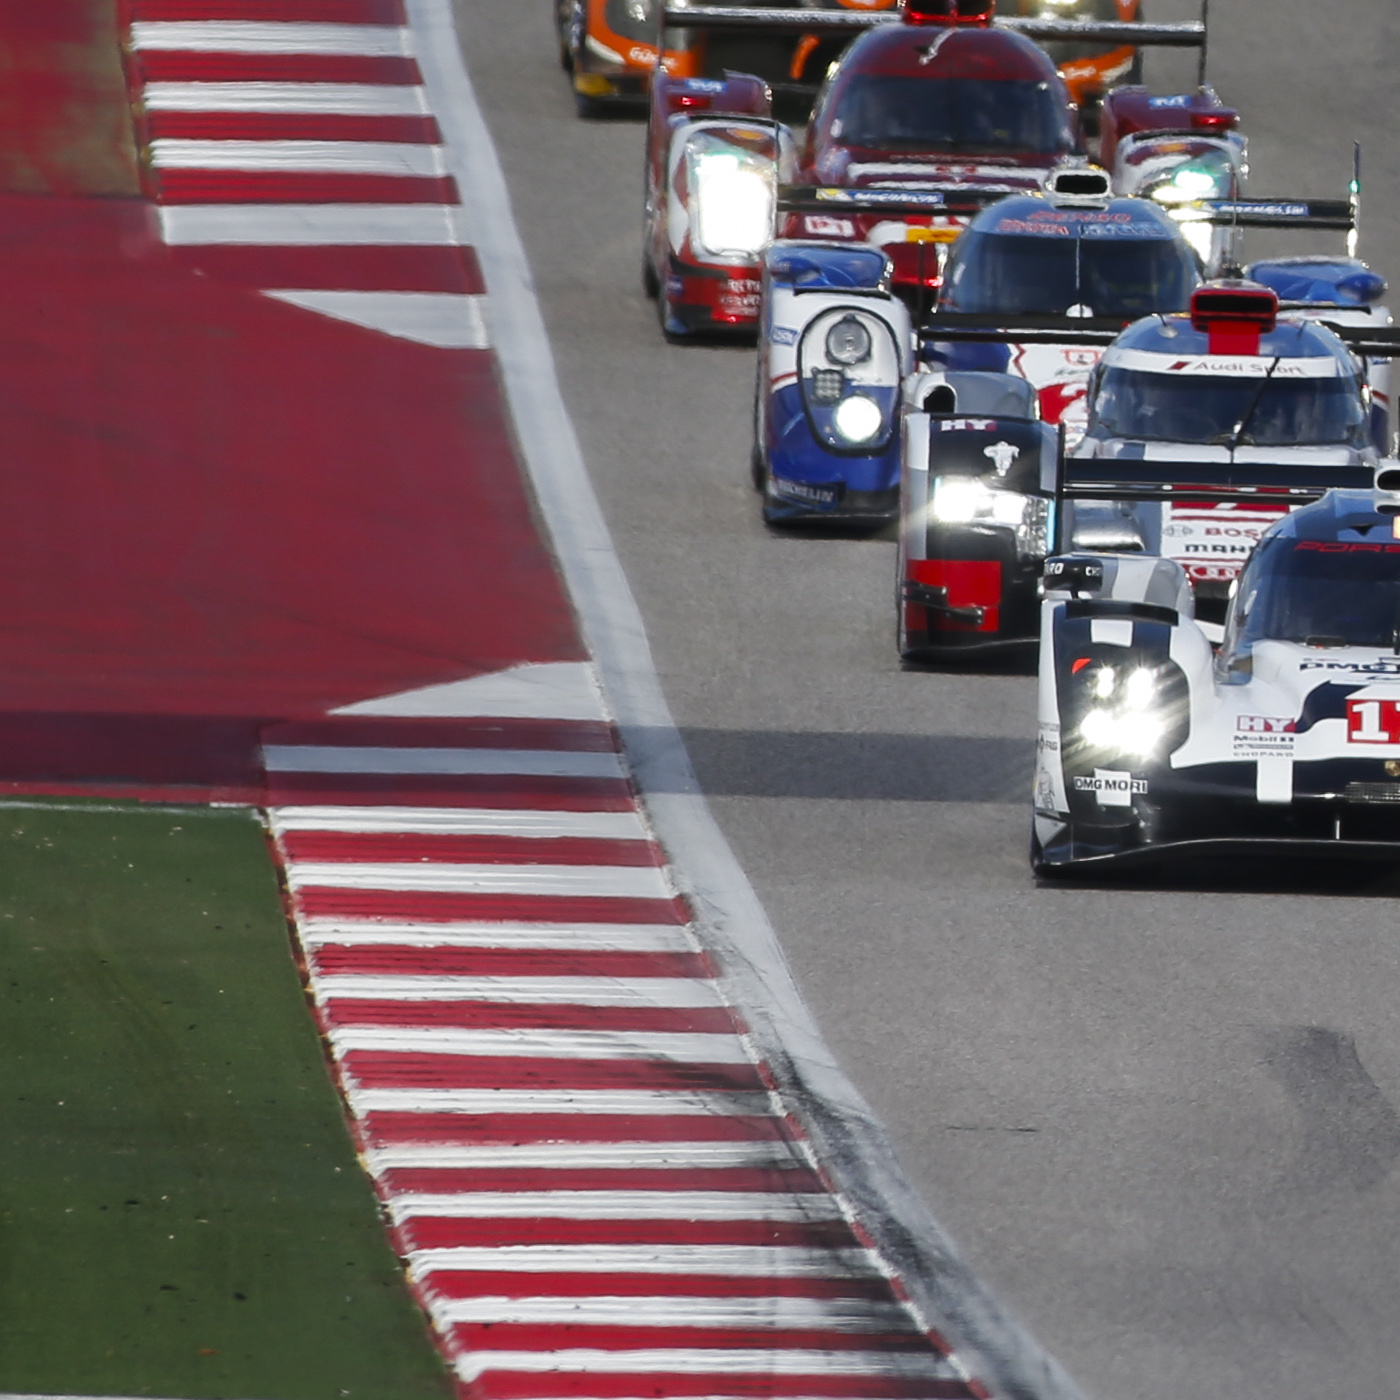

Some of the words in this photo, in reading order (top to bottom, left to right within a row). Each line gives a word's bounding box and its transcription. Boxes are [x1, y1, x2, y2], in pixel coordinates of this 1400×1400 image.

[1194, 362, 1244, 373] Audi
[941, 419, 995, 431] HY
[1205, 527, 1261, 538] BOS
[1300, 662, 1392, 673] DMG
[1240, 716, 1294, 732] HY
[1076, 778, 1103, 791] DMG
[1105, 779, 1148, 793] MORI
